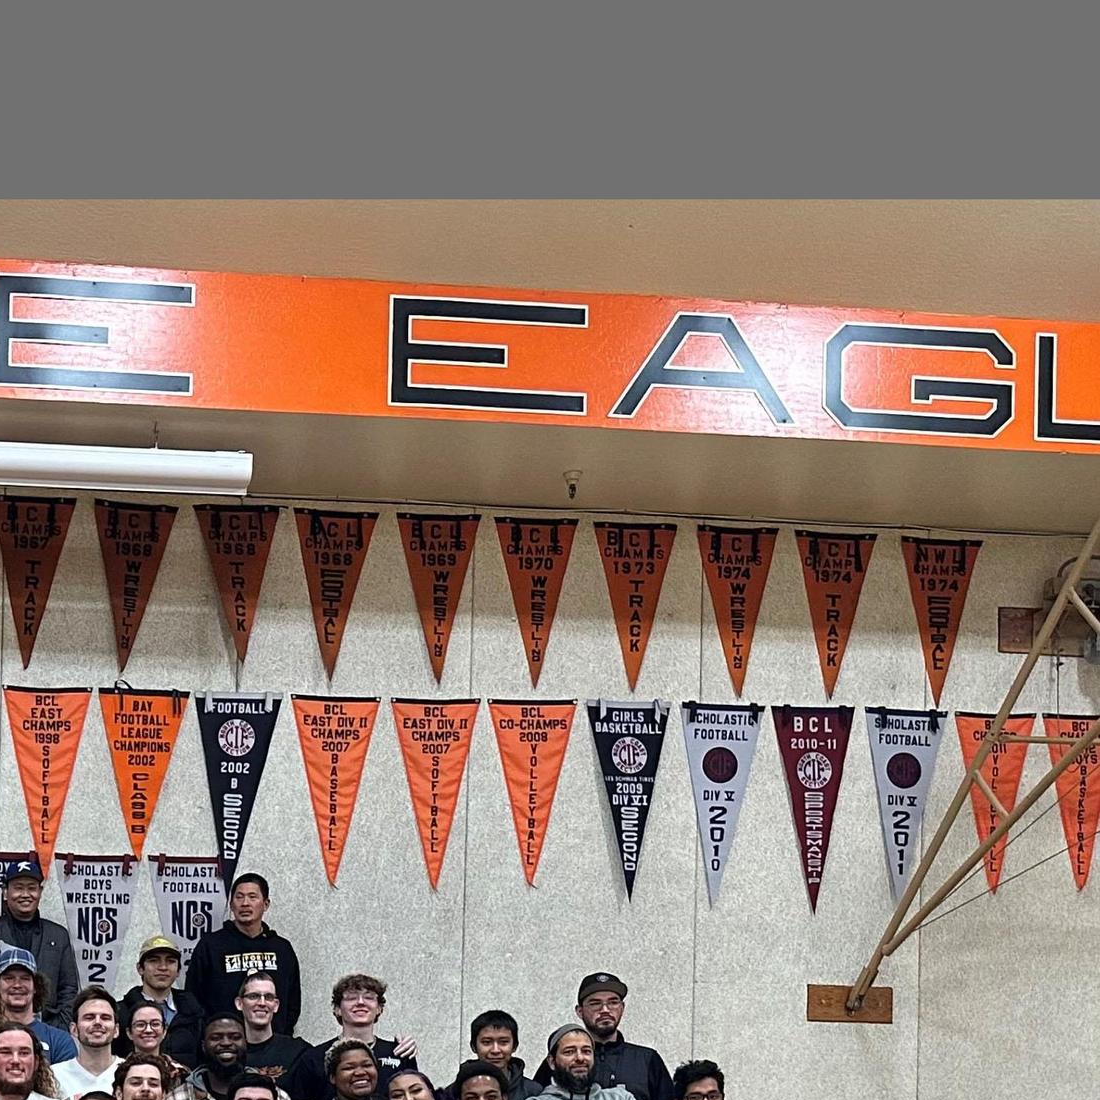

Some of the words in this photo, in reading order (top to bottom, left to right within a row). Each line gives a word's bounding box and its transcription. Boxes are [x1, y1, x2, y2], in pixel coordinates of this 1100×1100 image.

[314, 552, 353, 566] 1968
[613, 561, 656, 575] 1973
[718, 566, 751, 579] 1974
[920, 578, 959, 592] 1974
[320, 569, 346, 644] FOOTBALL
[628, 580, 645, 652] TRACK
[729, 583, 746, 669] WRESTLING
[928, 596, 952, 670] FOOTBALL
[35, 695, 58, 706] BCL
[133, 702, 153, 712] BAY
[211, 702, 265, 714] FOOTBALL
[324, 704, 346, 715] BCL
[424, 706, 447, 717] BCL
[521, 707, 544, 717] BCL
[31, 708, 63, 718] EAST
[612, 711, 644, 722] GIRLS
[114, 714, 169, 725] FOOTBALL
[304, 715, 332, 727] EAST
[337, 717, 355, 727] DIV
[403, 718, 434, 729] EAST
[438, 719, 456, 730] DIV
[499, 719, 567, 730] CO-CHAMPS
[794, 717, 832, 732] BCL
[23, 720, 71, 731] CHAMPS
[595, 722, 662, 734] BASKETBALL
[35, 733, 60, 744] 1998
[121, 728, 163, 739] LEAGUE
[311, 728, 360, 740] CHAMPS
[412, 731, 460, 741] CHAMPS
[519, 732, 547, 742] 2008
[694, 729, 748, 741] FOOTBALL
[113, 740, 170, 752] CHAMPIONS
[322, 741, 350, 752] 2007
[422, 743, 450, 754] 2007
[791, 738, 837, 749] 2010-11
[128, 755, 155, 766] 2002
[221, 762, 249, 774] 2002
[231, 779, 238, 788] B
[616, 783, 643, 794] 2009
[131, 773, 149, 819] CLASS
[613, 794, 629, 805] DIV
[630, 795, 648, 805] VI
[703, 790, 721, 801] DIV
[724, 791, 734, 801] V
[328, 754, 338, 850] BASEBALL
[431, 756, 439, 853] SOFTBALL
[526, 744, 537, 864] VOLLEYBALL
[132, 825, 145, 834] B
[224, 794, 242, 859] SECOND
[621, 806, 638, 871] SECOND
[709, 806, 727, 871] 2010
[84, 880, 111, 890] BOYS
[66, 893, 130, 904] WRESTLING
[82, 950, 102, 960] DIV
[106, 951, 113, 961] 3
